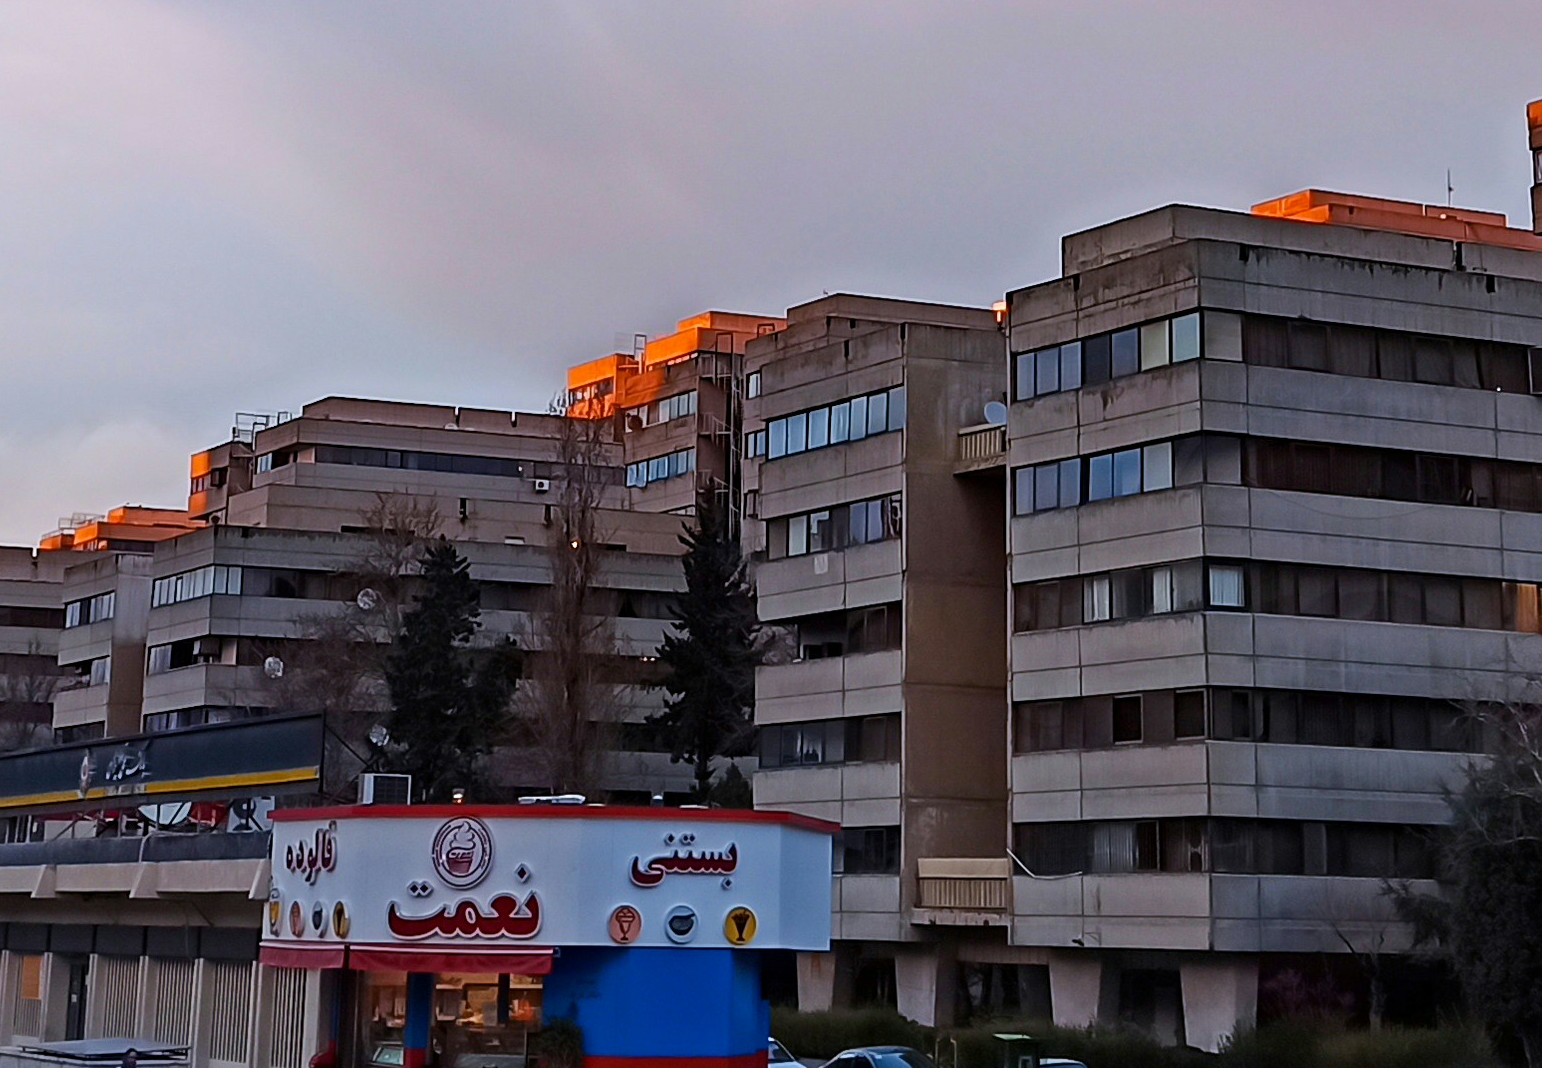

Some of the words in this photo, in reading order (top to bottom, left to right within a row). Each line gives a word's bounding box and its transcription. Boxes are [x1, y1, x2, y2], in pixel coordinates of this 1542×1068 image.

[286, 820, 337, 883] فالوده
[630, 833, 739, 889] بستنی
[387, 863, 542, 939] نعمت
